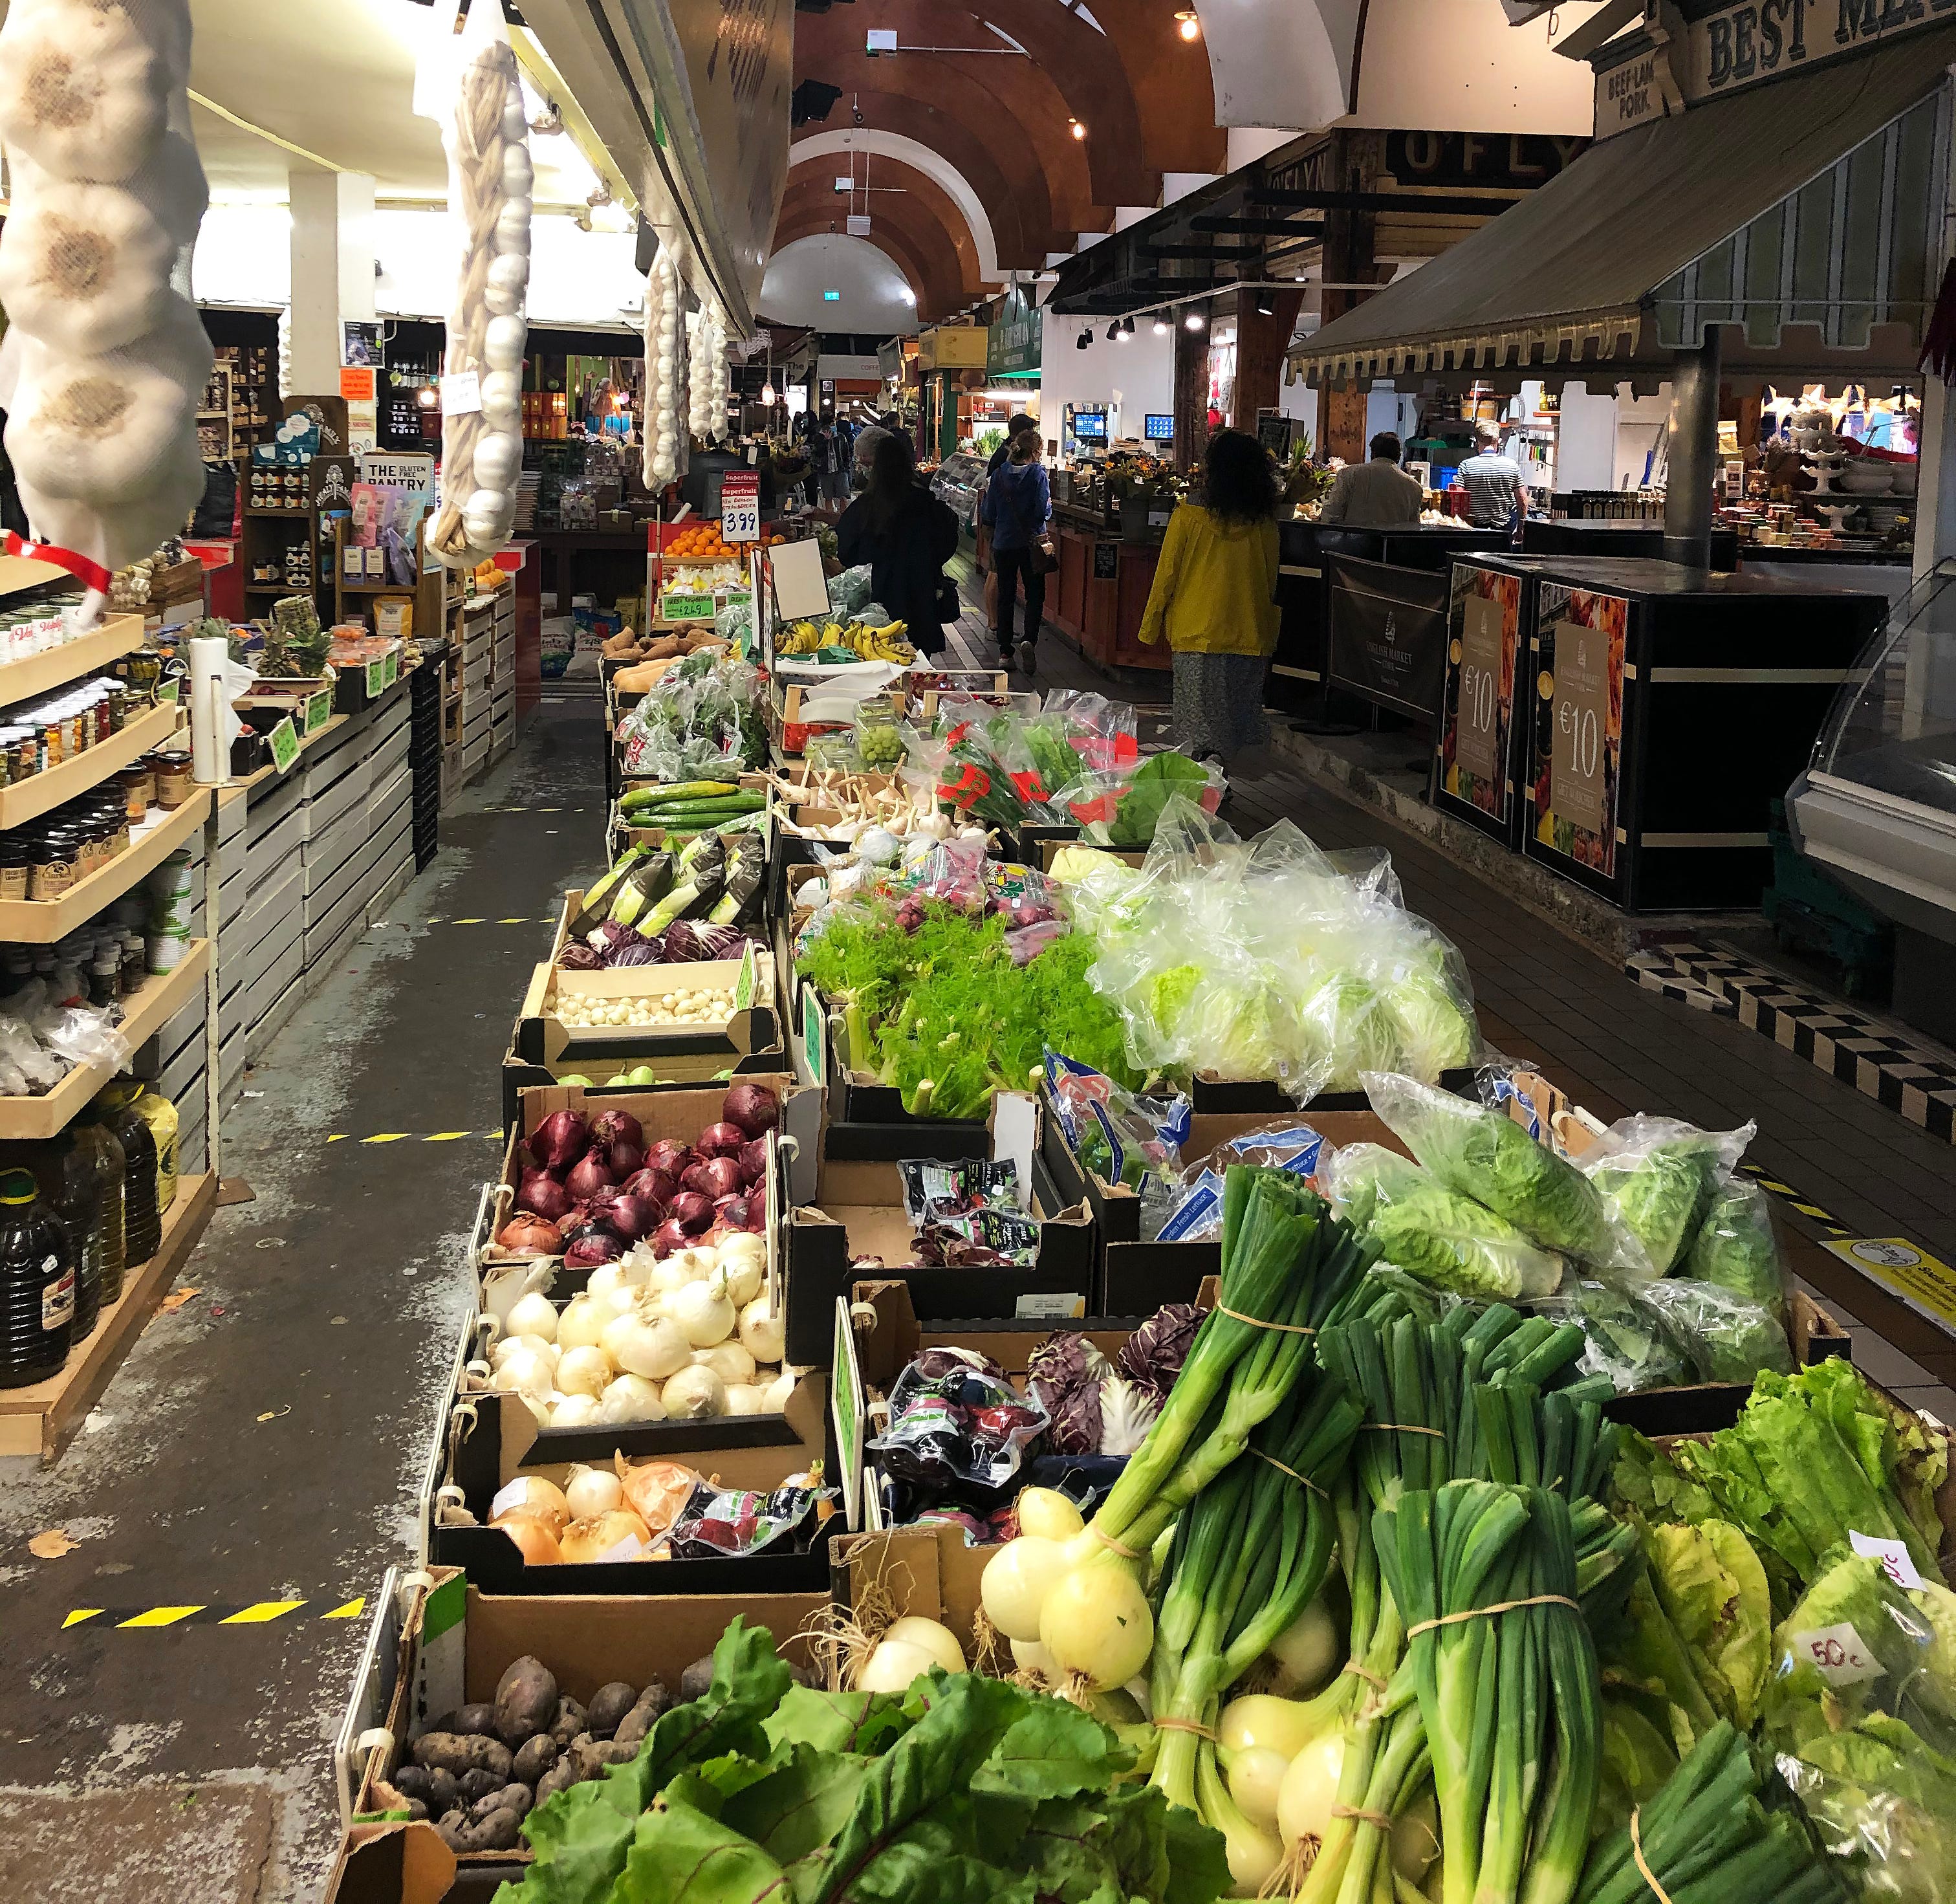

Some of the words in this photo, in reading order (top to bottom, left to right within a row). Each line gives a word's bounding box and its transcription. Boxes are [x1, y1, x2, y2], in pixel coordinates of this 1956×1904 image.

[1708, 0, 1806, 88] BEST
[1619, 88, 1651, 120] PORK
[369, 465, 397, 477] THE
[1388, 648, 1413, 665] MARKET
[1465, 665, 1492, 732] €10
[1559, 701, 1598, 778] €10
[1189, 1193, 1208, 1213] Lettuce
